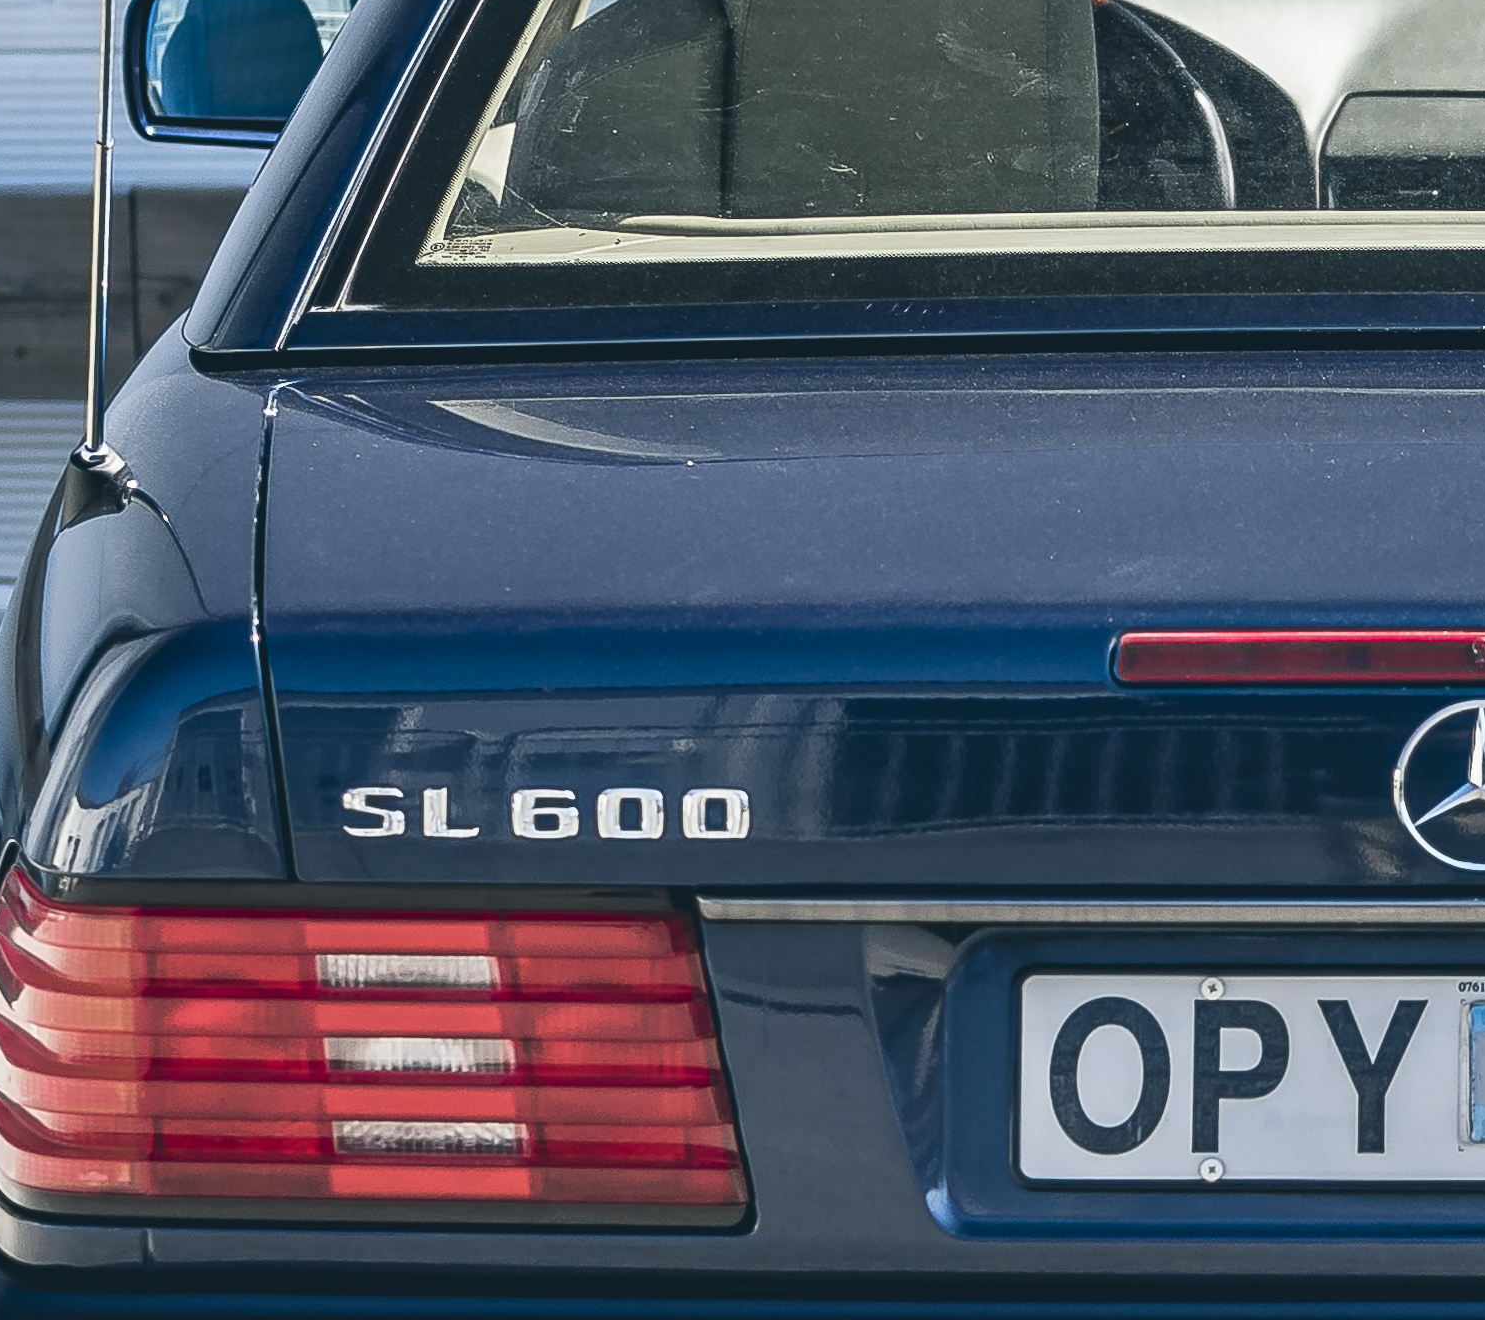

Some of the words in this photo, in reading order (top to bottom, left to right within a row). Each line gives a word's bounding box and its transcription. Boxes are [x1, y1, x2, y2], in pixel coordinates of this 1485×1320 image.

[341, 785, 481, 840] SL
[510, 786, 752, 841] 600
[1048, 995, 1430, 1156] OPY
